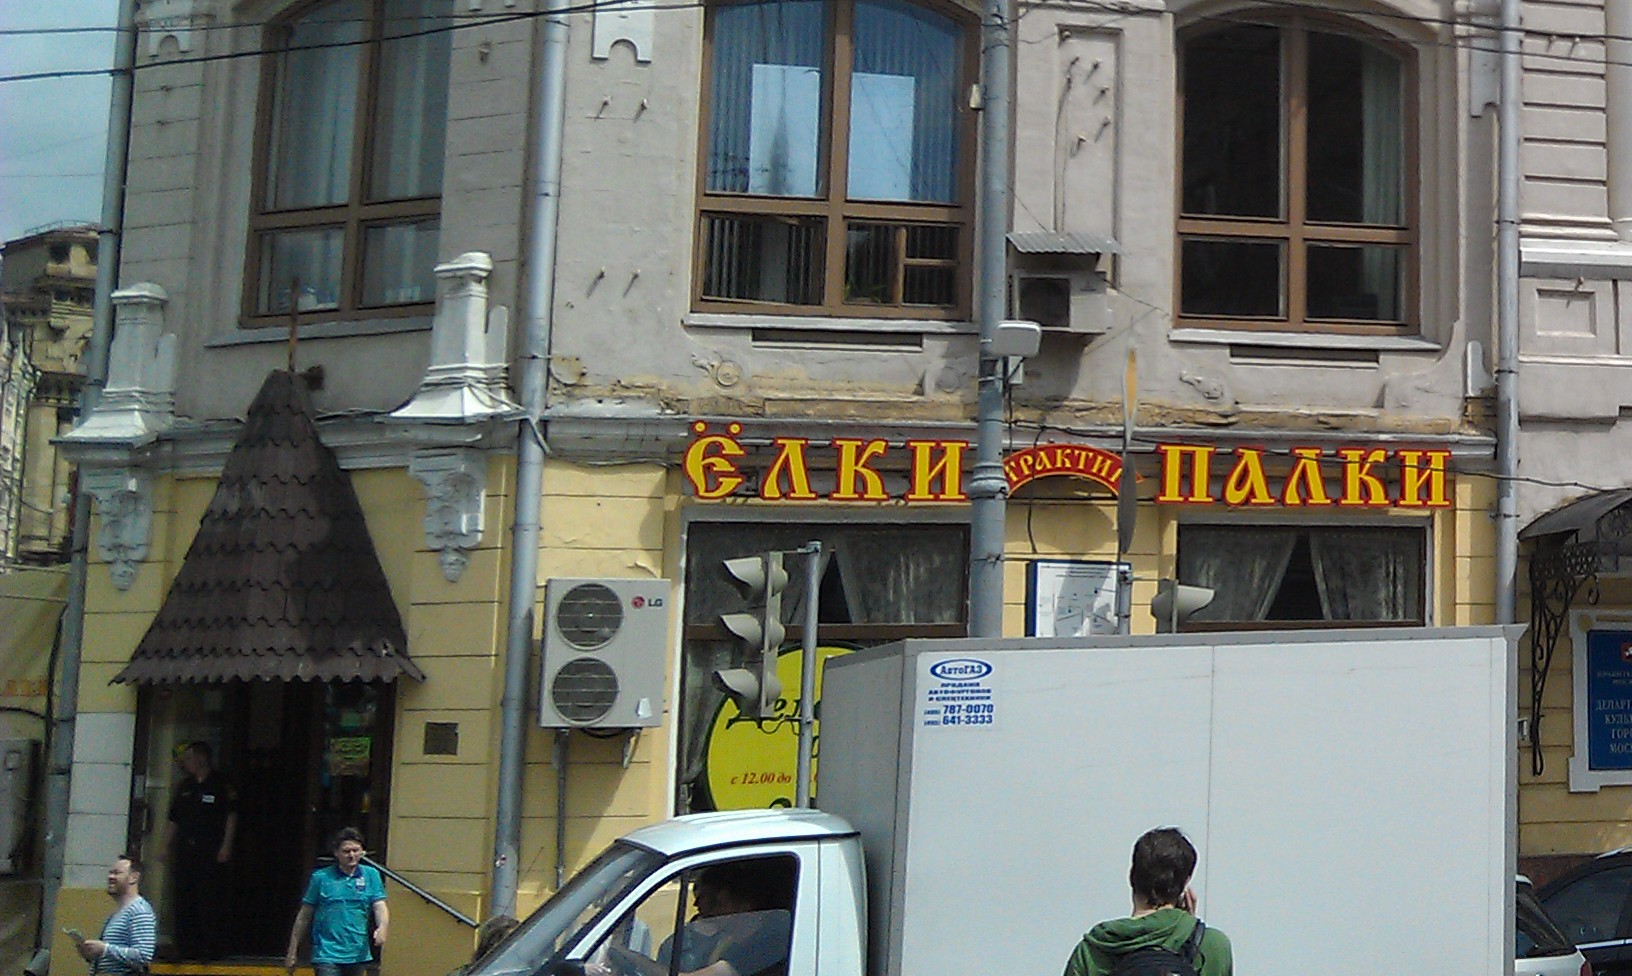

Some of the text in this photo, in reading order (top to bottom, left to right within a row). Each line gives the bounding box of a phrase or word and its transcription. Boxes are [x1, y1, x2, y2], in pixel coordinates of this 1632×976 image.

[684, 421, 969, 501] ЁЛКИ
[1155, 443, 1452, 507] ПАЛКИ
[648, 598, 663, 607] LG
[943, 704, 994, 714] 787-0070
[943, 715, 993, 725] 641-3333
[741, 772, 774, 785] 12.00
